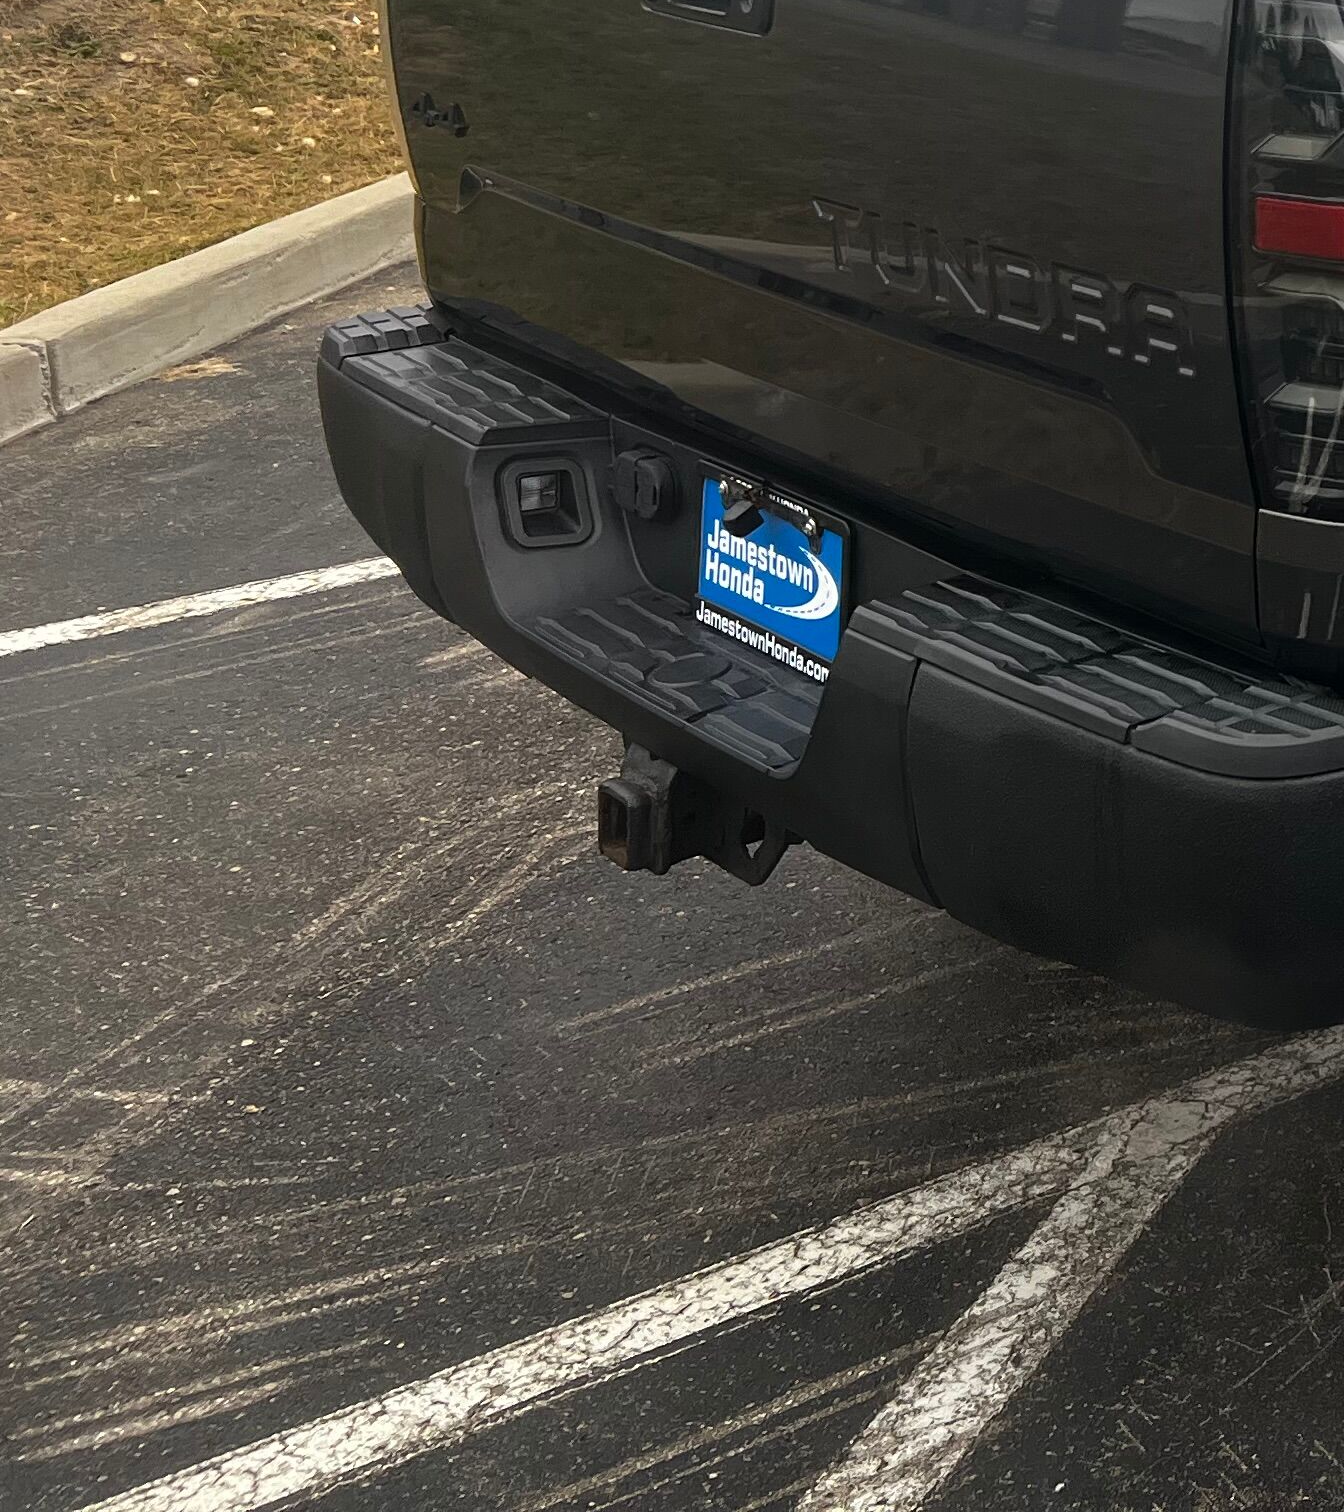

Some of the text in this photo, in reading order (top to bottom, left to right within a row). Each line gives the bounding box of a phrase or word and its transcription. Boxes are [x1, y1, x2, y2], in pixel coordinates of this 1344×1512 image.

[812, 195, 1195, 377] TUNDRA
[705, 548, 764, 605] Honda
[707, 519, 814, 594] Jamestown
